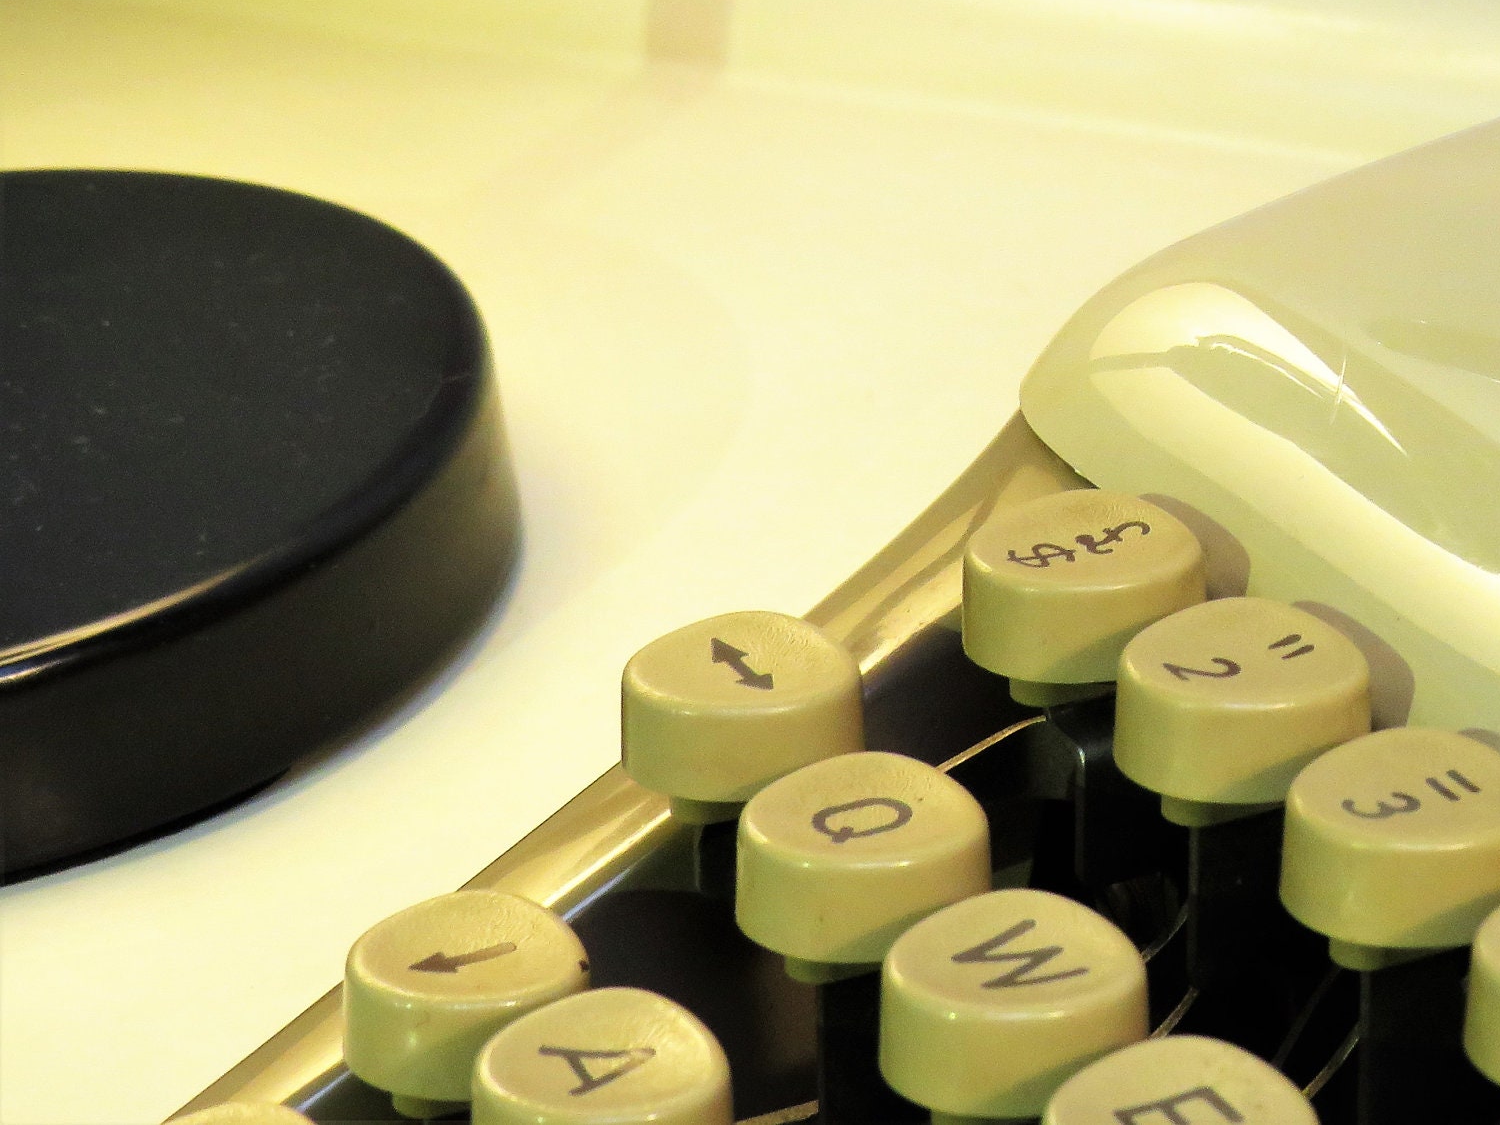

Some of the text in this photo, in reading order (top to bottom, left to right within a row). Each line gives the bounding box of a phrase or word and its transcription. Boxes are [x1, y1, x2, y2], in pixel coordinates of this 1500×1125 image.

[1007, 543, 1078, 568] $
[1162, 656, 1242, 682] 2
[811, 796, 914, 844] Q
[1341, 790, 1421, 819] 3
[949, 918, 1089, 991] W
[539, 1044, 657, 1097] A
